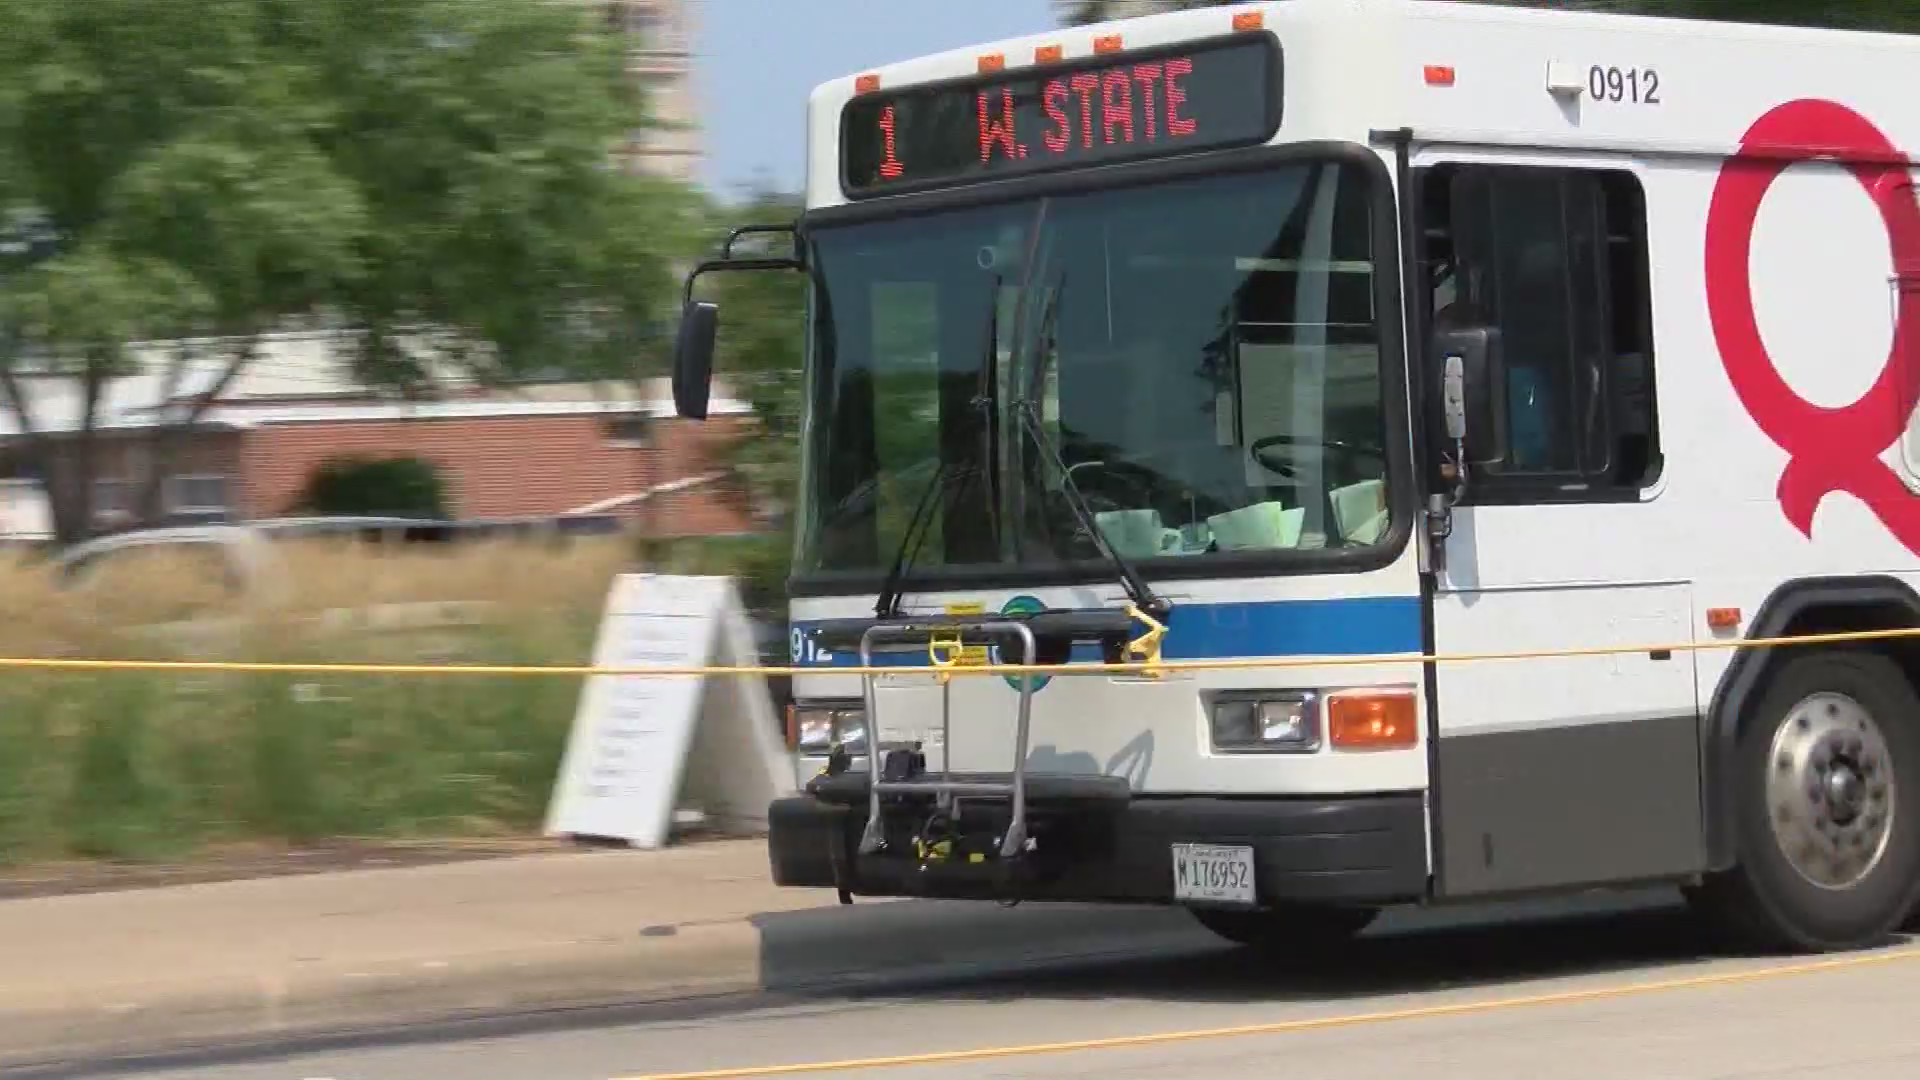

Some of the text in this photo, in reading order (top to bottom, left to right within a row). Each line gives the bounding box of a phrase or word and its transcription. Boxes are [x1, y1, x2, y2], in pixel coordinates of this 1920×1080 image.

[879, 57, 1196, 179] 1 W. STATE
[1589, 65, 1660, 103] 0912
